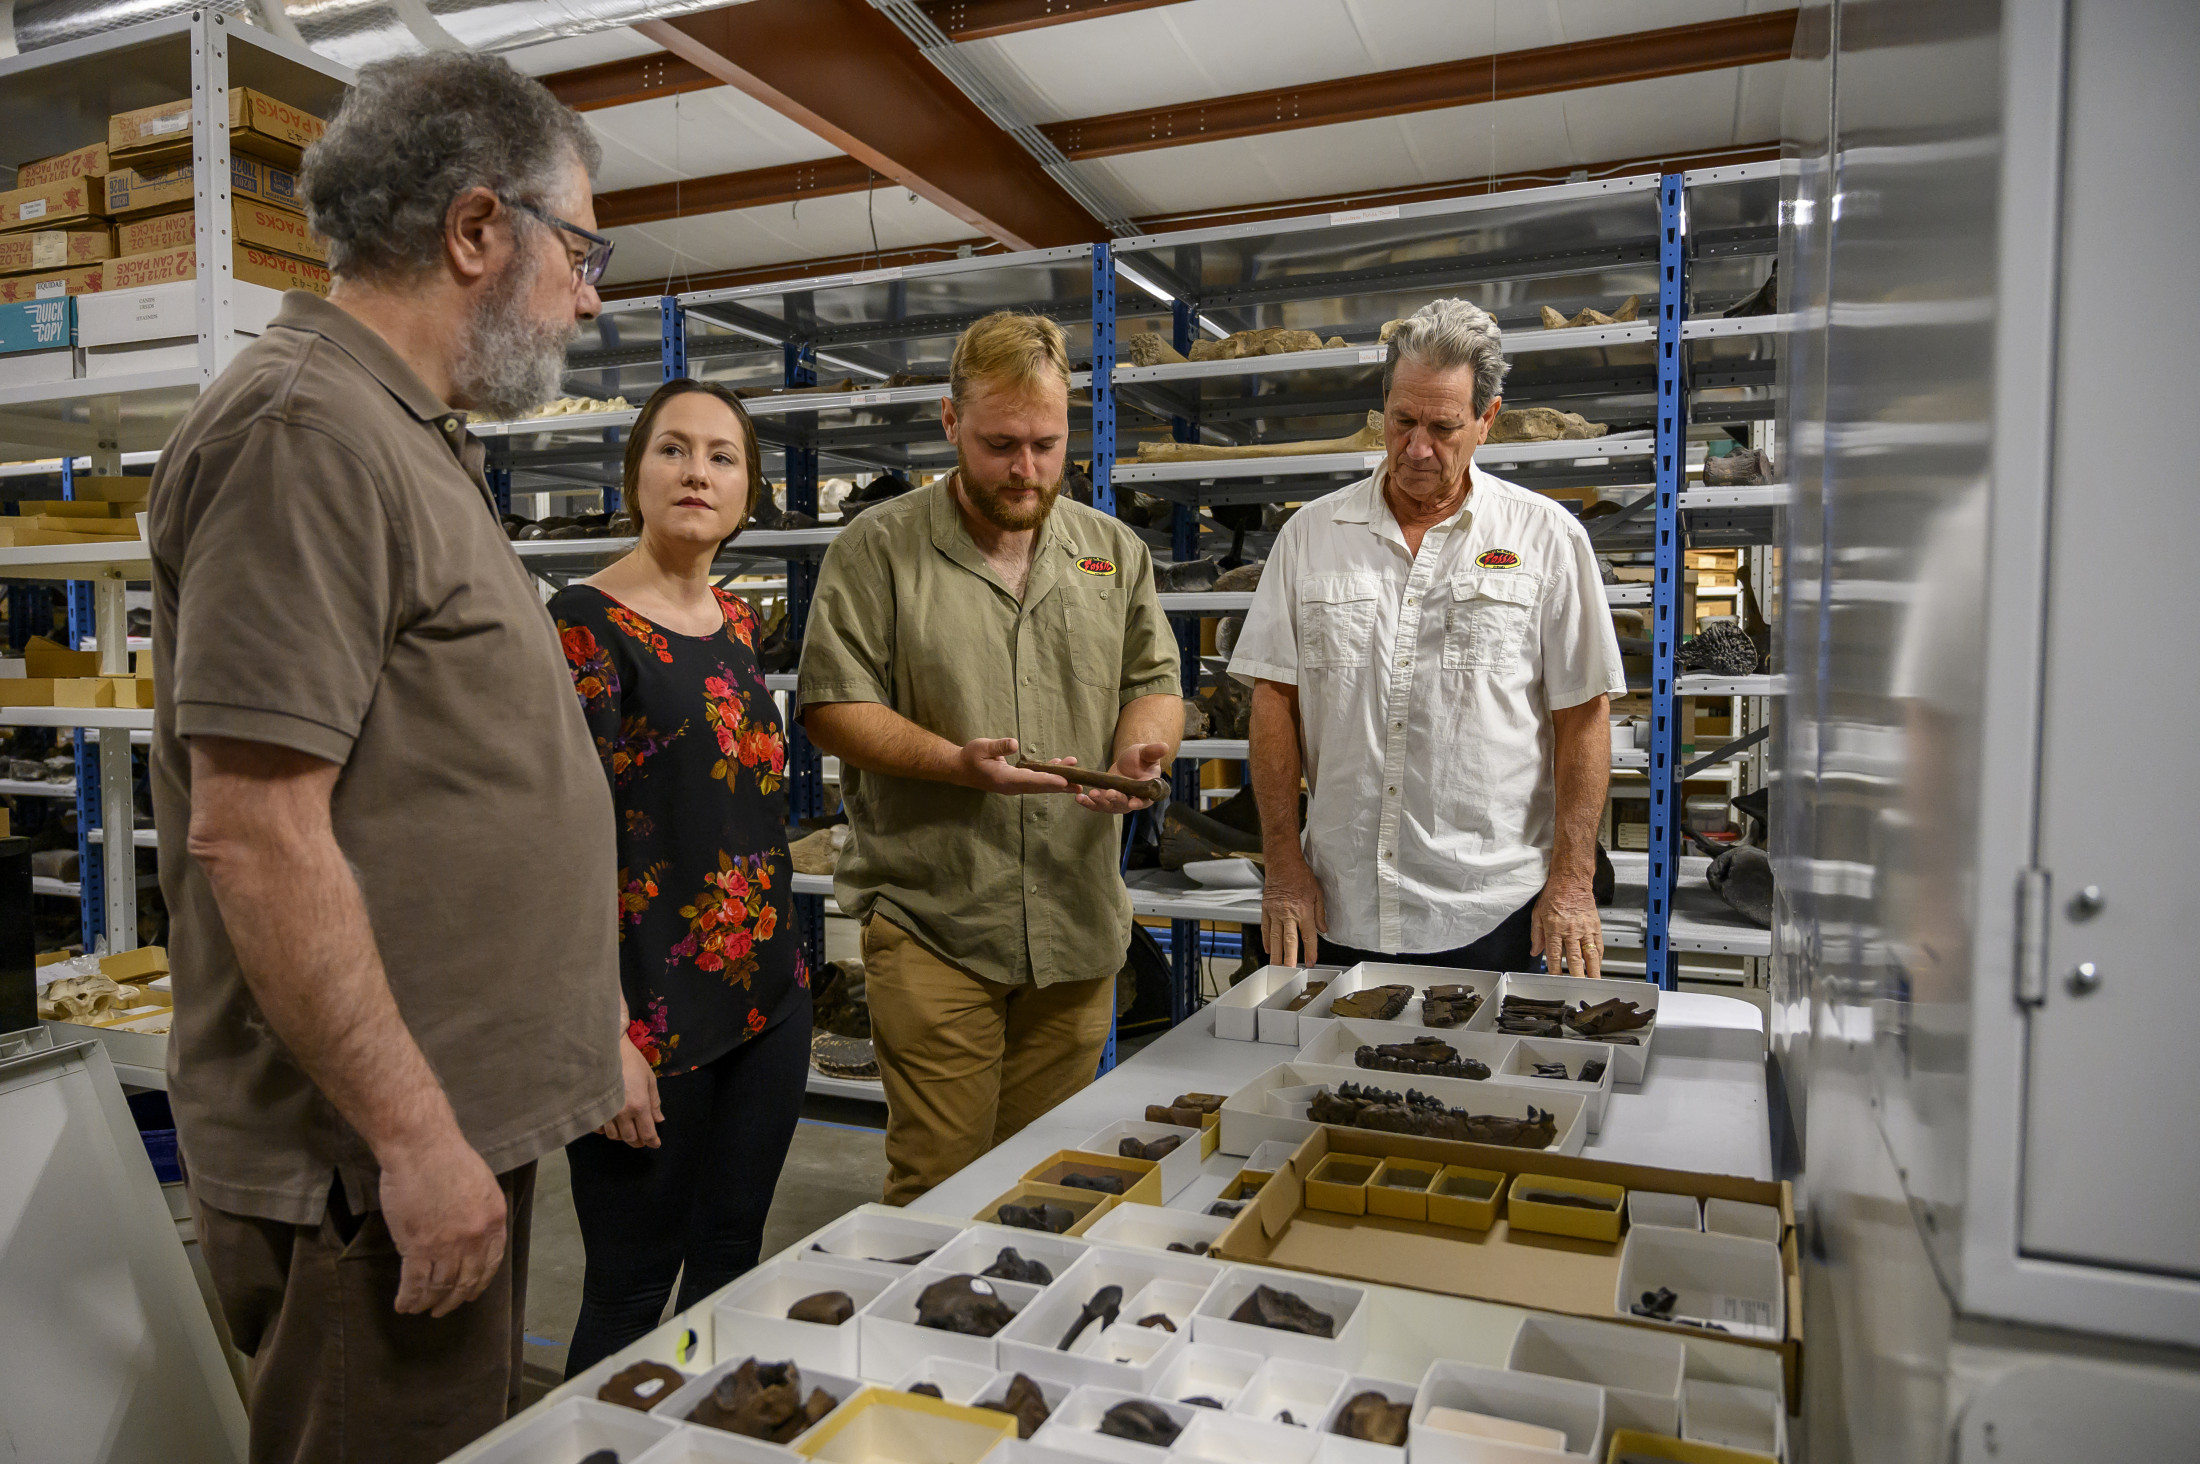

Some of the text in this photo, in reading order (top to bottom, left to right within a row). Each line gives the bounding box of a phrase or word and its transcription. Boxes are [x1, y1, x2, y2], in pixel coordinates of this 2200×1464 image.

[256, 98, 312, 133] PACKS
[26, 158, 70, 177] CAN PACKS
[71, 154, 82, 177] 2
[49, 171, 68, 183] 12/12
[109, 177, 129, 194] 71026
[131, 221, 161, 238] PACKS
[166, 217, 187, 231] CAN
[255, 211, 305, 238] PACKS
[162, 230, 186, 244] 12/12
[0, 241, 32, 254] PACKS
[117, 254, 174, 275] CAN PACKS
[176, 252, 189, 276] 2
[247, 250, 331, 282] CAN PACKS
[148, 267, 172, 281] 12/12
[37, 281, 63, 290] EQUIDAE
[24, 301, 64, 323] QUICK
[31, 321, 63, 343] COPY
